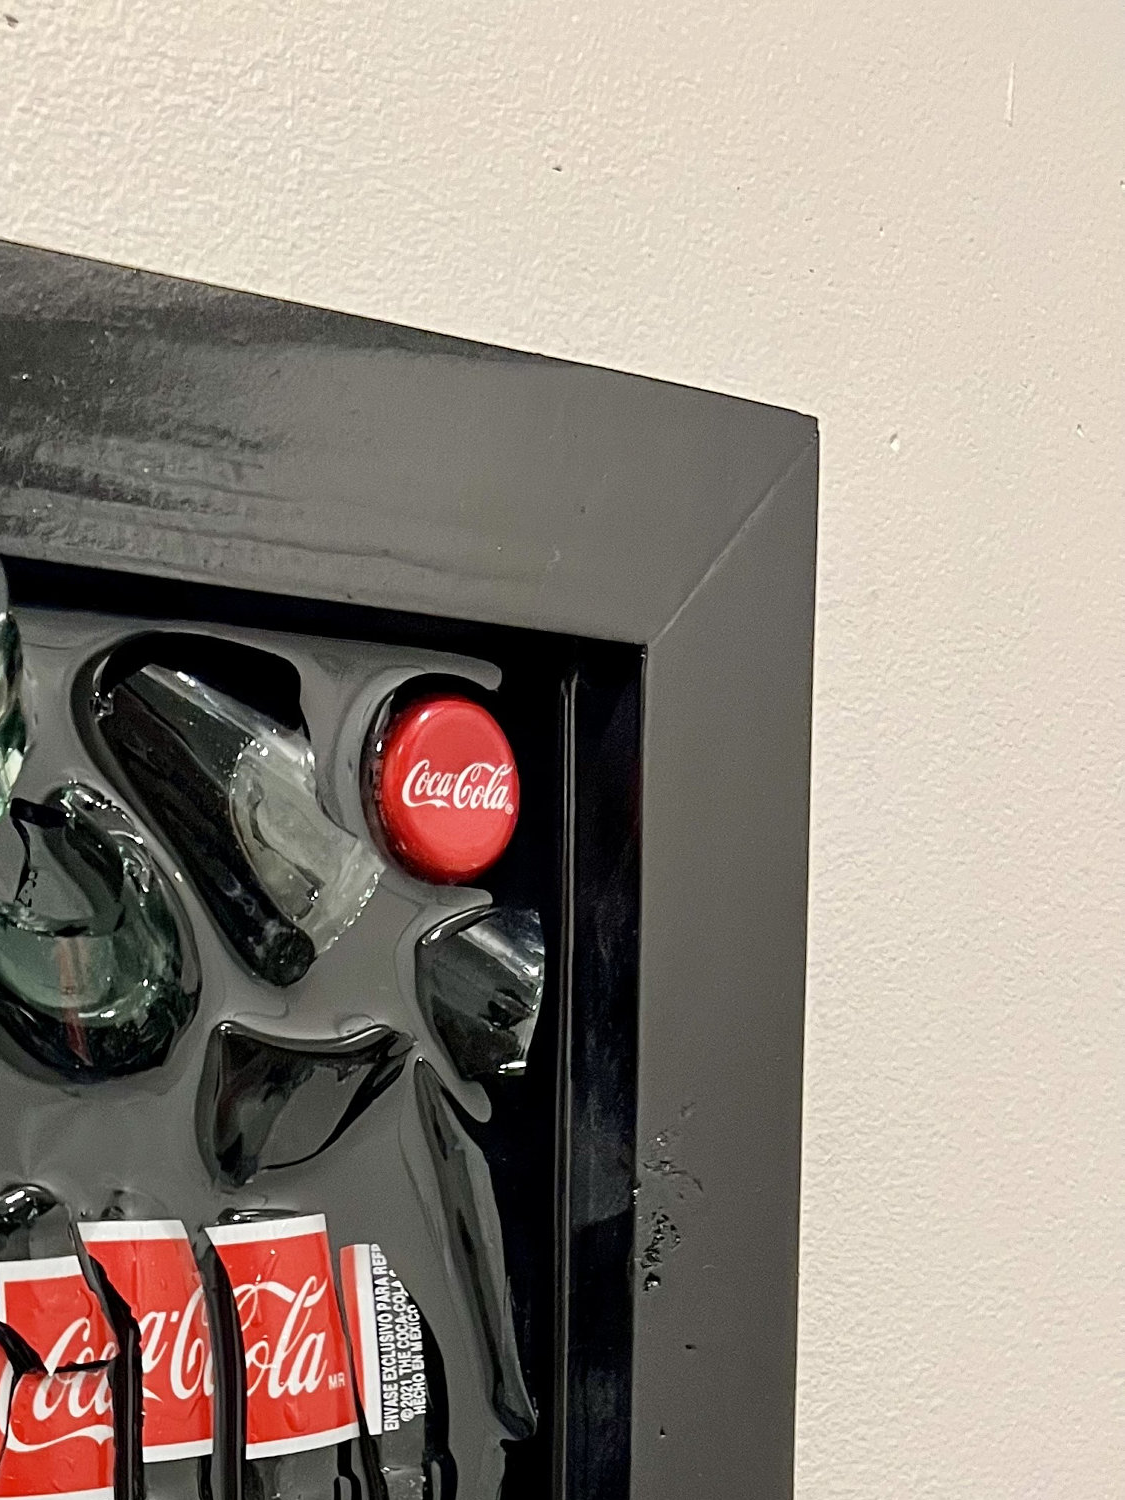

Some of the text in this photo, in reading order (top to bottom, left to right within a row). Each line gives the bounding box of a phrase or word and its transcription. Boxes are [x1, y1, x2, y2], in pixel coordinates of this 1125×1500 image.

[374, 1276, 392, 1311] PARA
[377, 1313, 399, 1381] EXCLUSIVO
[397, 1350, 413, 1376] THE
[411, 1355, 425, 1370] EN
[328, 1372, 346, 1391] MR
[412, 1373, 427, 1415] HECHO
[383, 1382, 401, 1431] ENVASE
